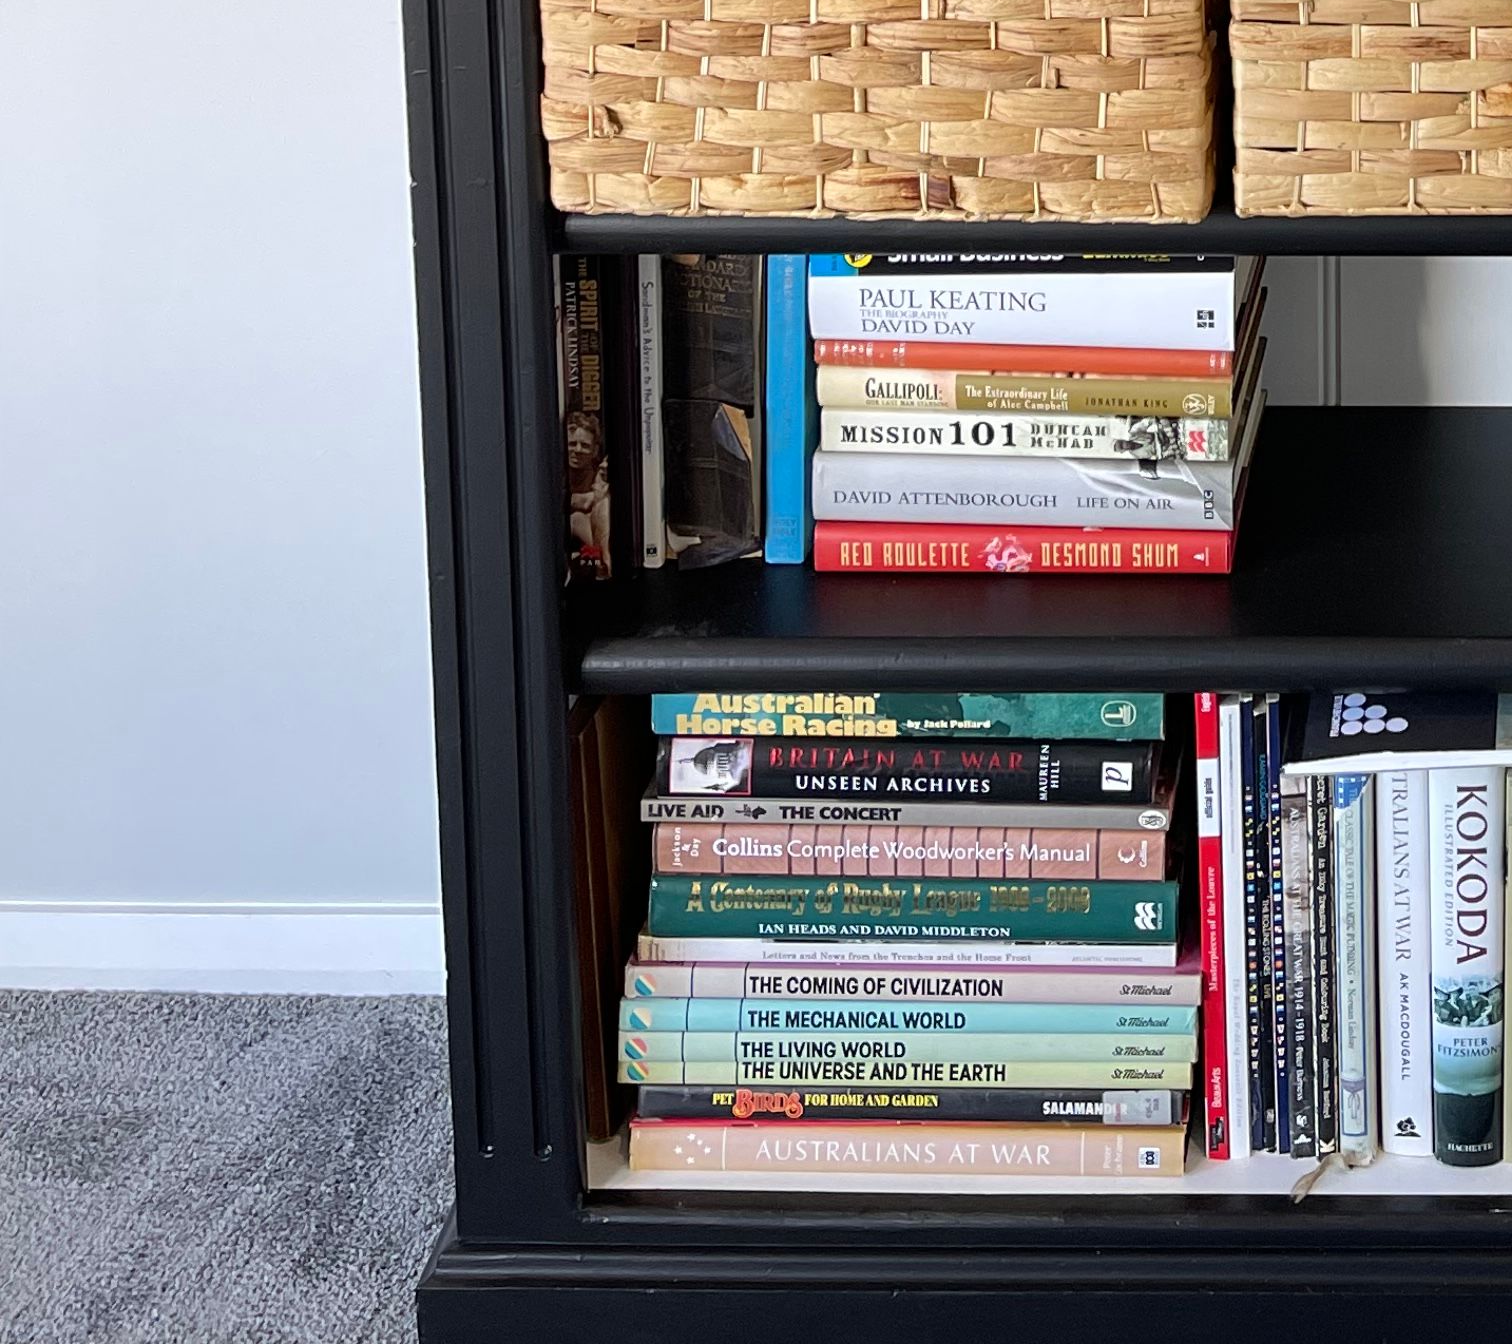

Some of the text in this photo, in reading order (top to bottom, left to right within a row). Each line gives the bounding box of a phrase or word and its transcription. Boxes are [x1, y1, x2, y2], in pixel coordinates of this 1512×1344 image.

[859, 288, 1047, 312] PAUL KEATING
[565, 281, 581, 389] PATRICK LINDSAY
[861, 318, 976, 335] DAVID DAY
[582, 354, 600, 412] DIGGER
[864, 377, 943, 401] GALLIPOLI:
[965, 385, 1068, 401] The Extraordinary Life
[1085, 397, 1169, 409] JONATHAN KING
[840, 420, 1017, 447] MISSION 101
[1029, 423, 1107, 437] DUNCAN
[1030, 436, 1094, 450] McNAB
[833, 490, 1057, 509] DAVID ATTENBOROUGH
[1076, 496, 1175, 511] LIFE ON AIR
[839, 541, 970, 568] RED ROULETTE
[1041, 542, 1179, 568] DESMOND SHUM
[692, 693, 877, 714] Australian
[676, 713, 897, 737] Horse Racing
[768, 746, 1025, 771] BRITAIN AT WAR
[795, 775, 991, 793] UNSEEN ARCHIVES
[1038, 743, 1050, 801] MAUREEN
[1050, 759, 1060, 789] HILL
[647, 804, 902, 822] LIVE AID THE CONCERT
[712, 838, 1090, 863] Collins Complete Woodworker's Manual
[1444, 803, 1454, 947] ILLUSTRATED EDITION
[1456, 784, 1488, 965] KOKODA
[759, 923, 1011, 938] IAN HEADS AND DAVID MIDDLETON
[750, 976, 1004, 997] THE COMING OF CIVILIZATION
[748, 1010, 966, 1030] THE MECHANICAL WORLD
[1399, 972, 1412, 1081] AK MACDOUGALL
[741, 1041, 906, 1058] THE LIVING WORLD
[1453, 1037, 1488, 1046] PETER
[742, 1061, 1006, 1082] THE UNIVERSE AND THE EARTH
[712, 1088, 939, 1119] PET BIRDS FOR HOME AND GARDEN
[755, 1139, 1050, 1165] AUSTRALIANS AT WAR
